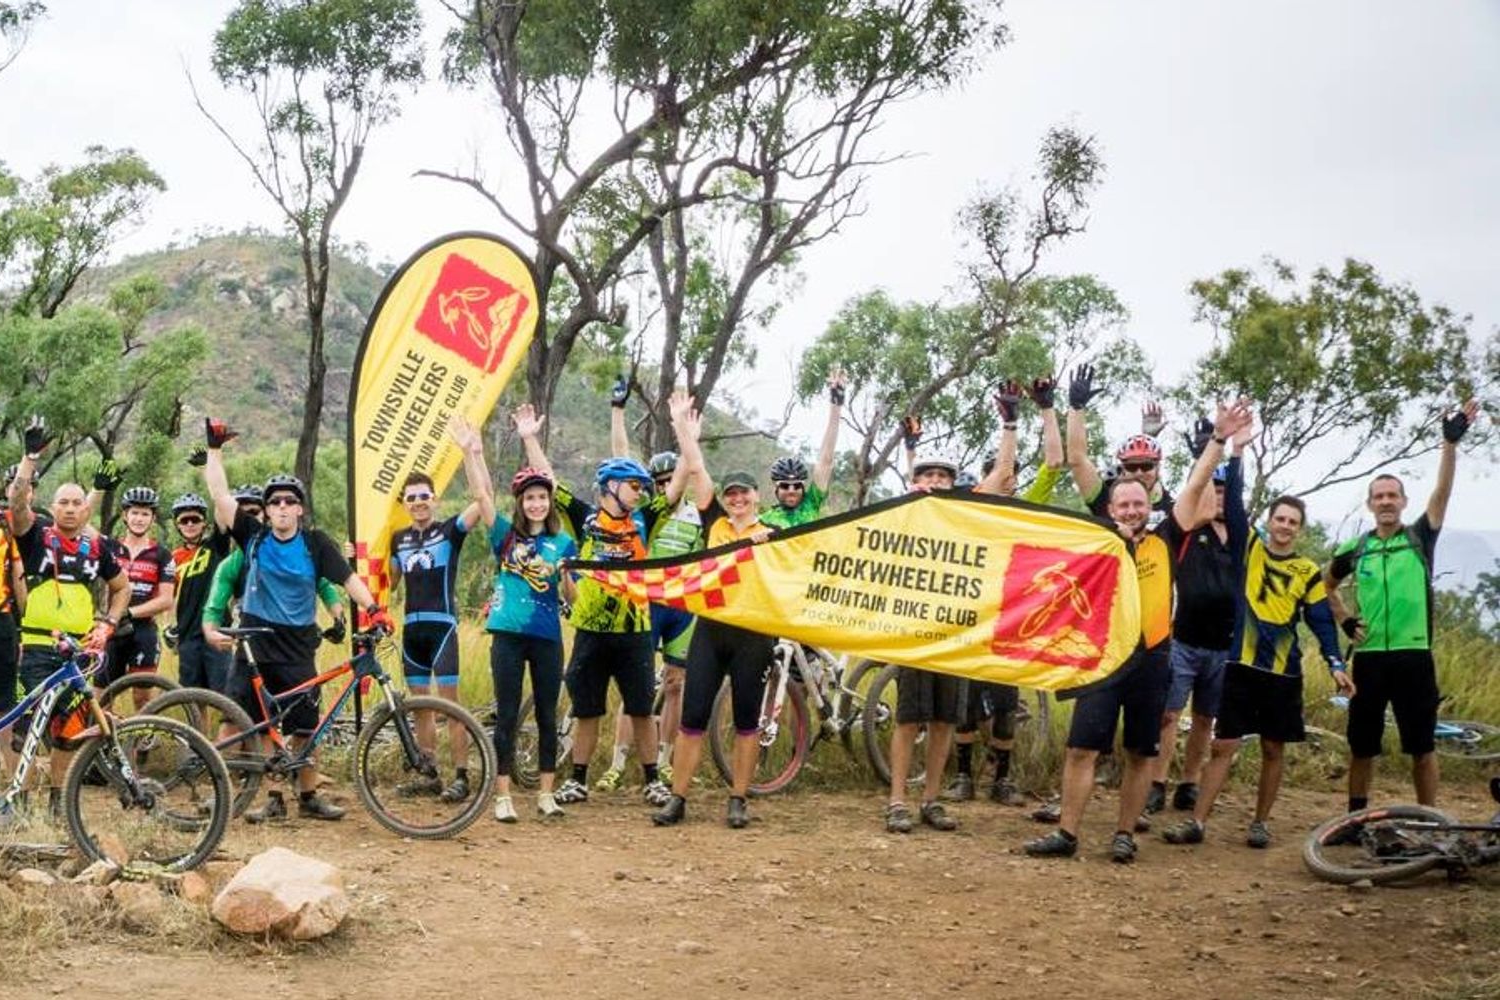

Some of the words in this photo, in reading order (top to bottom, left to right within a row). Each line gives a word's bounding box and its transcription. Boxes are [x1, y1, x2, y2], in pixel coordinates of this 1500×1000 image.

[362, 350, 425, 453] TOWNSVILLE
[372, 362, 448, 494] ROCKWHEELERS
[428, 409, 451, 441] BIKE
[445, 374, 468, 409] CLUB
[813, 551, 983, 599] ROCKWHEELERS
[857, 526, 988, 568] TOWNSVILLE
[806, 583, 888, 613] MOUNTAIN
[892, 599, 930, 620] BIKE
[935, 605, 978, 627] CLUB
